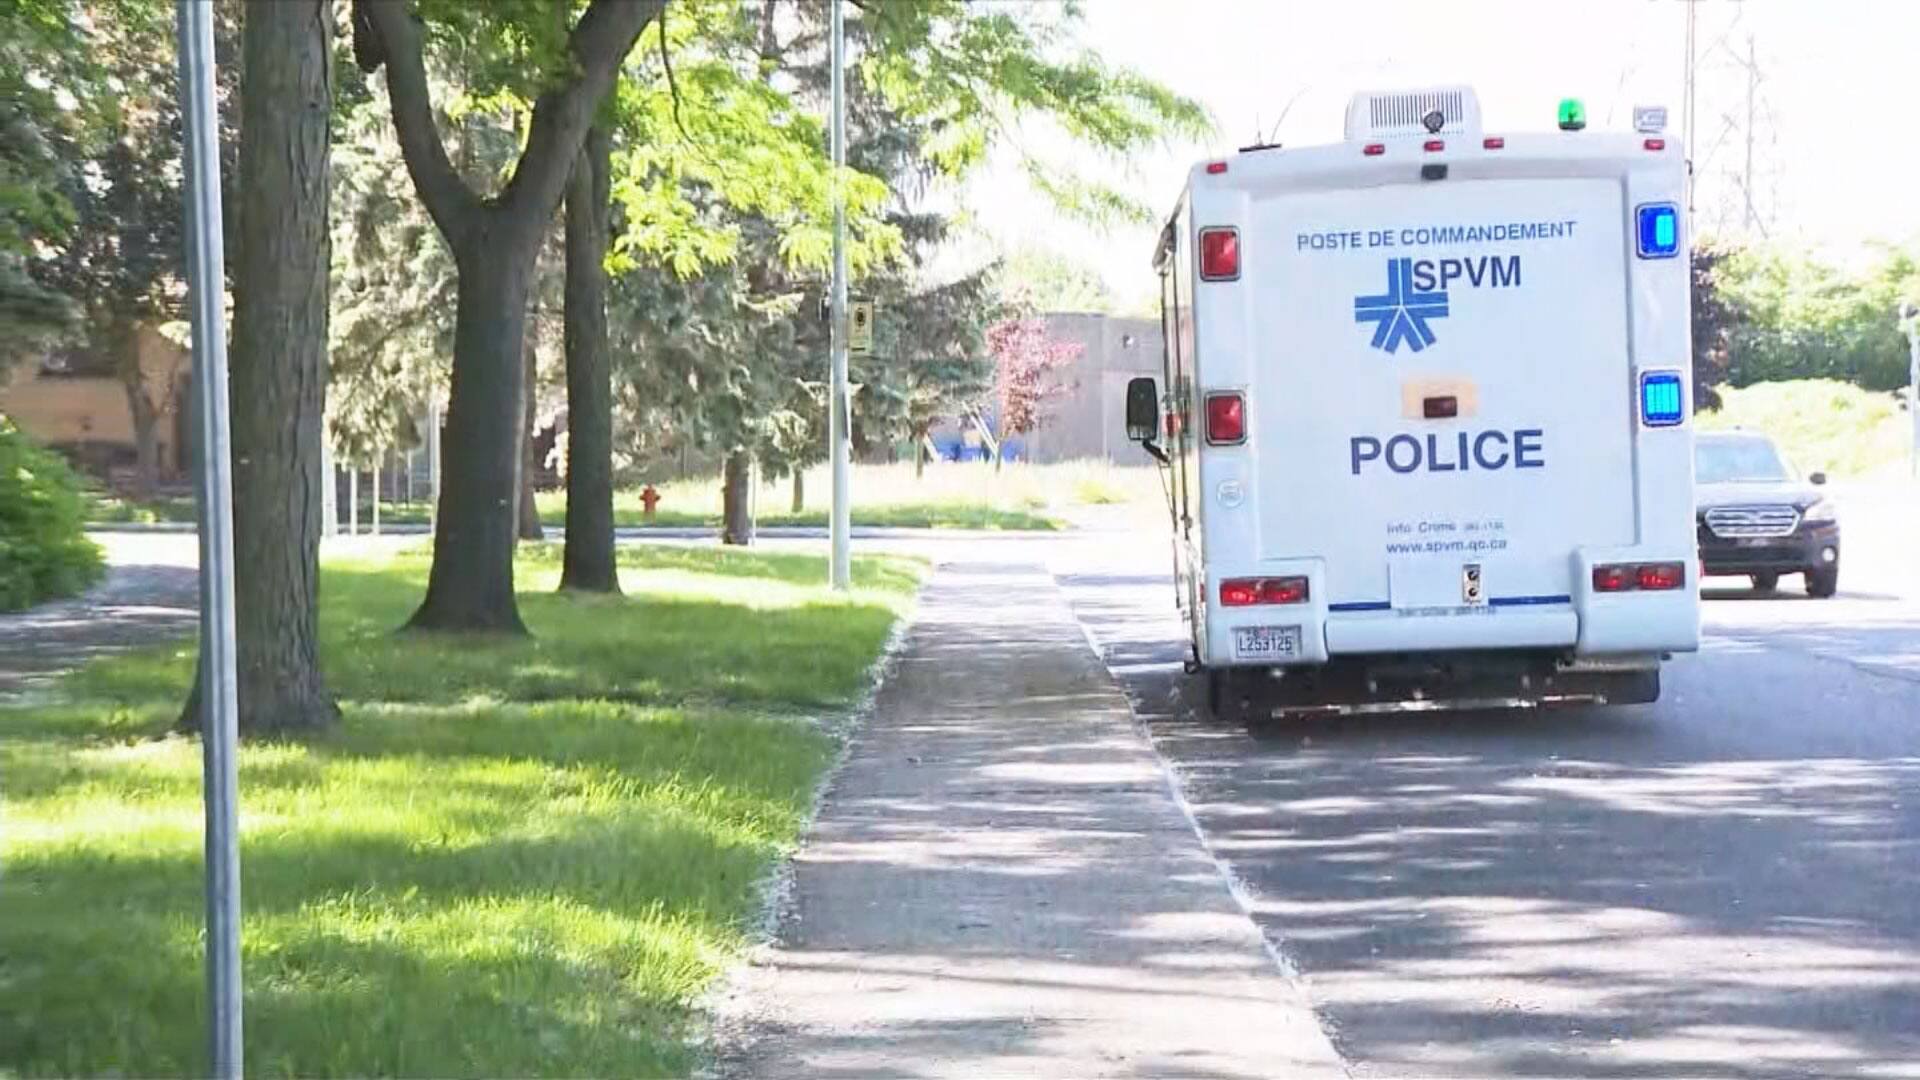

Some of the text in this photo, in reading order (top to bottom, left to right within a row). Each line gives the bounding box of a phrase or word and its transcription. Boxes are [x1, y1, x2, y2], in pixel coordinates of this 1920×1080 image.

[1297, 220, 1577, 250] POSTE DE COMMANDEMENT
[1412, 255, 1522, 292] SPVM
[1350, 429, 1545, 475] POLICE
[1386, 539, 1507, 553] www.spvm.qc.ca
